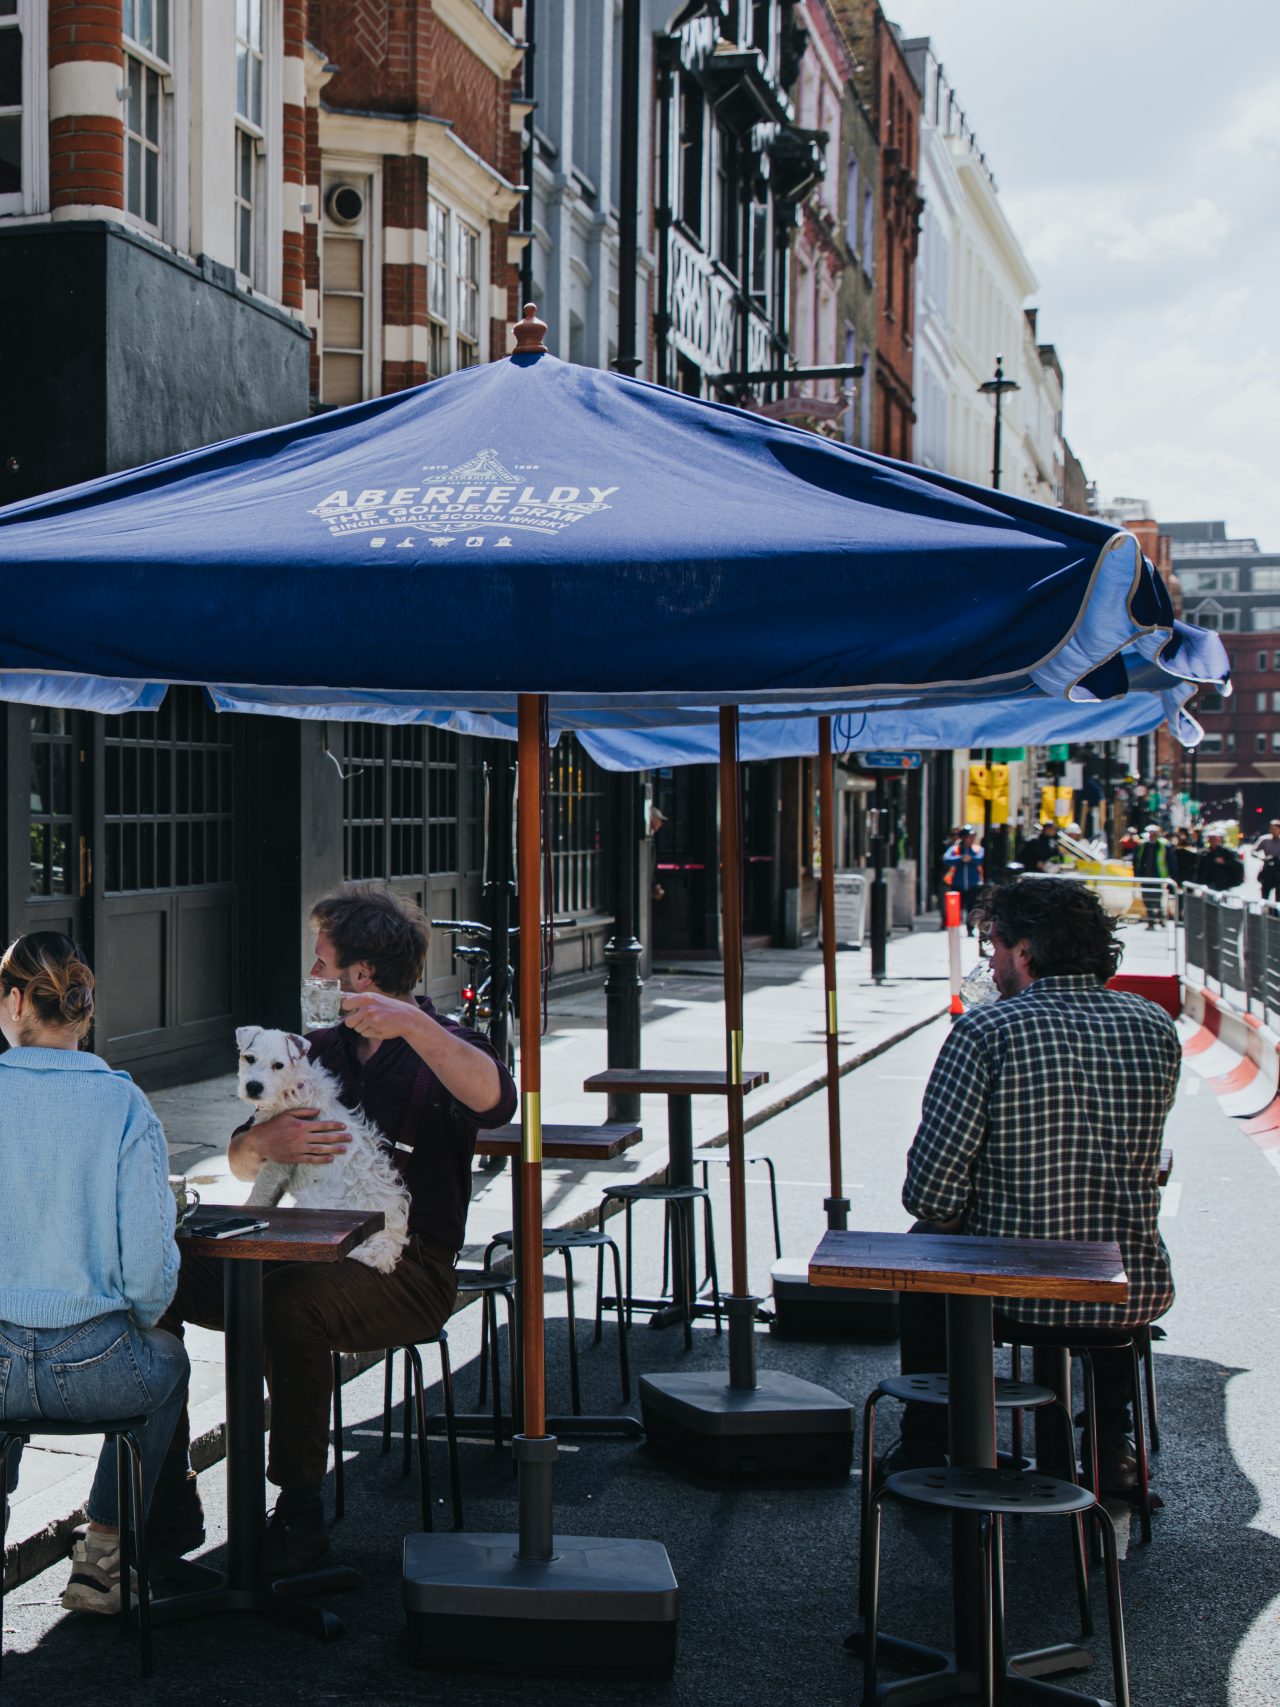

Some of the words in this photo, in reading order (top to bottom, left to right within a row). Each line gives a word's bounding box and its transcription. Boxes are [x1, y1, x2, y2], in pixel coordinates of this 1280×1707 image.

[316, 486, 619, 507] ABERFELDY
[321, 510, 380, 525] THE
[388, 503, 503, 516] GOLDEN
[508, 506, 585, 523] DRAM
[328, 518, 390, 533] SINGLE
[394, 514, 436, 523] MALT
[438, 513, 507, 522] SCOTCH
[508, 516, 570, 530] WHISKY
